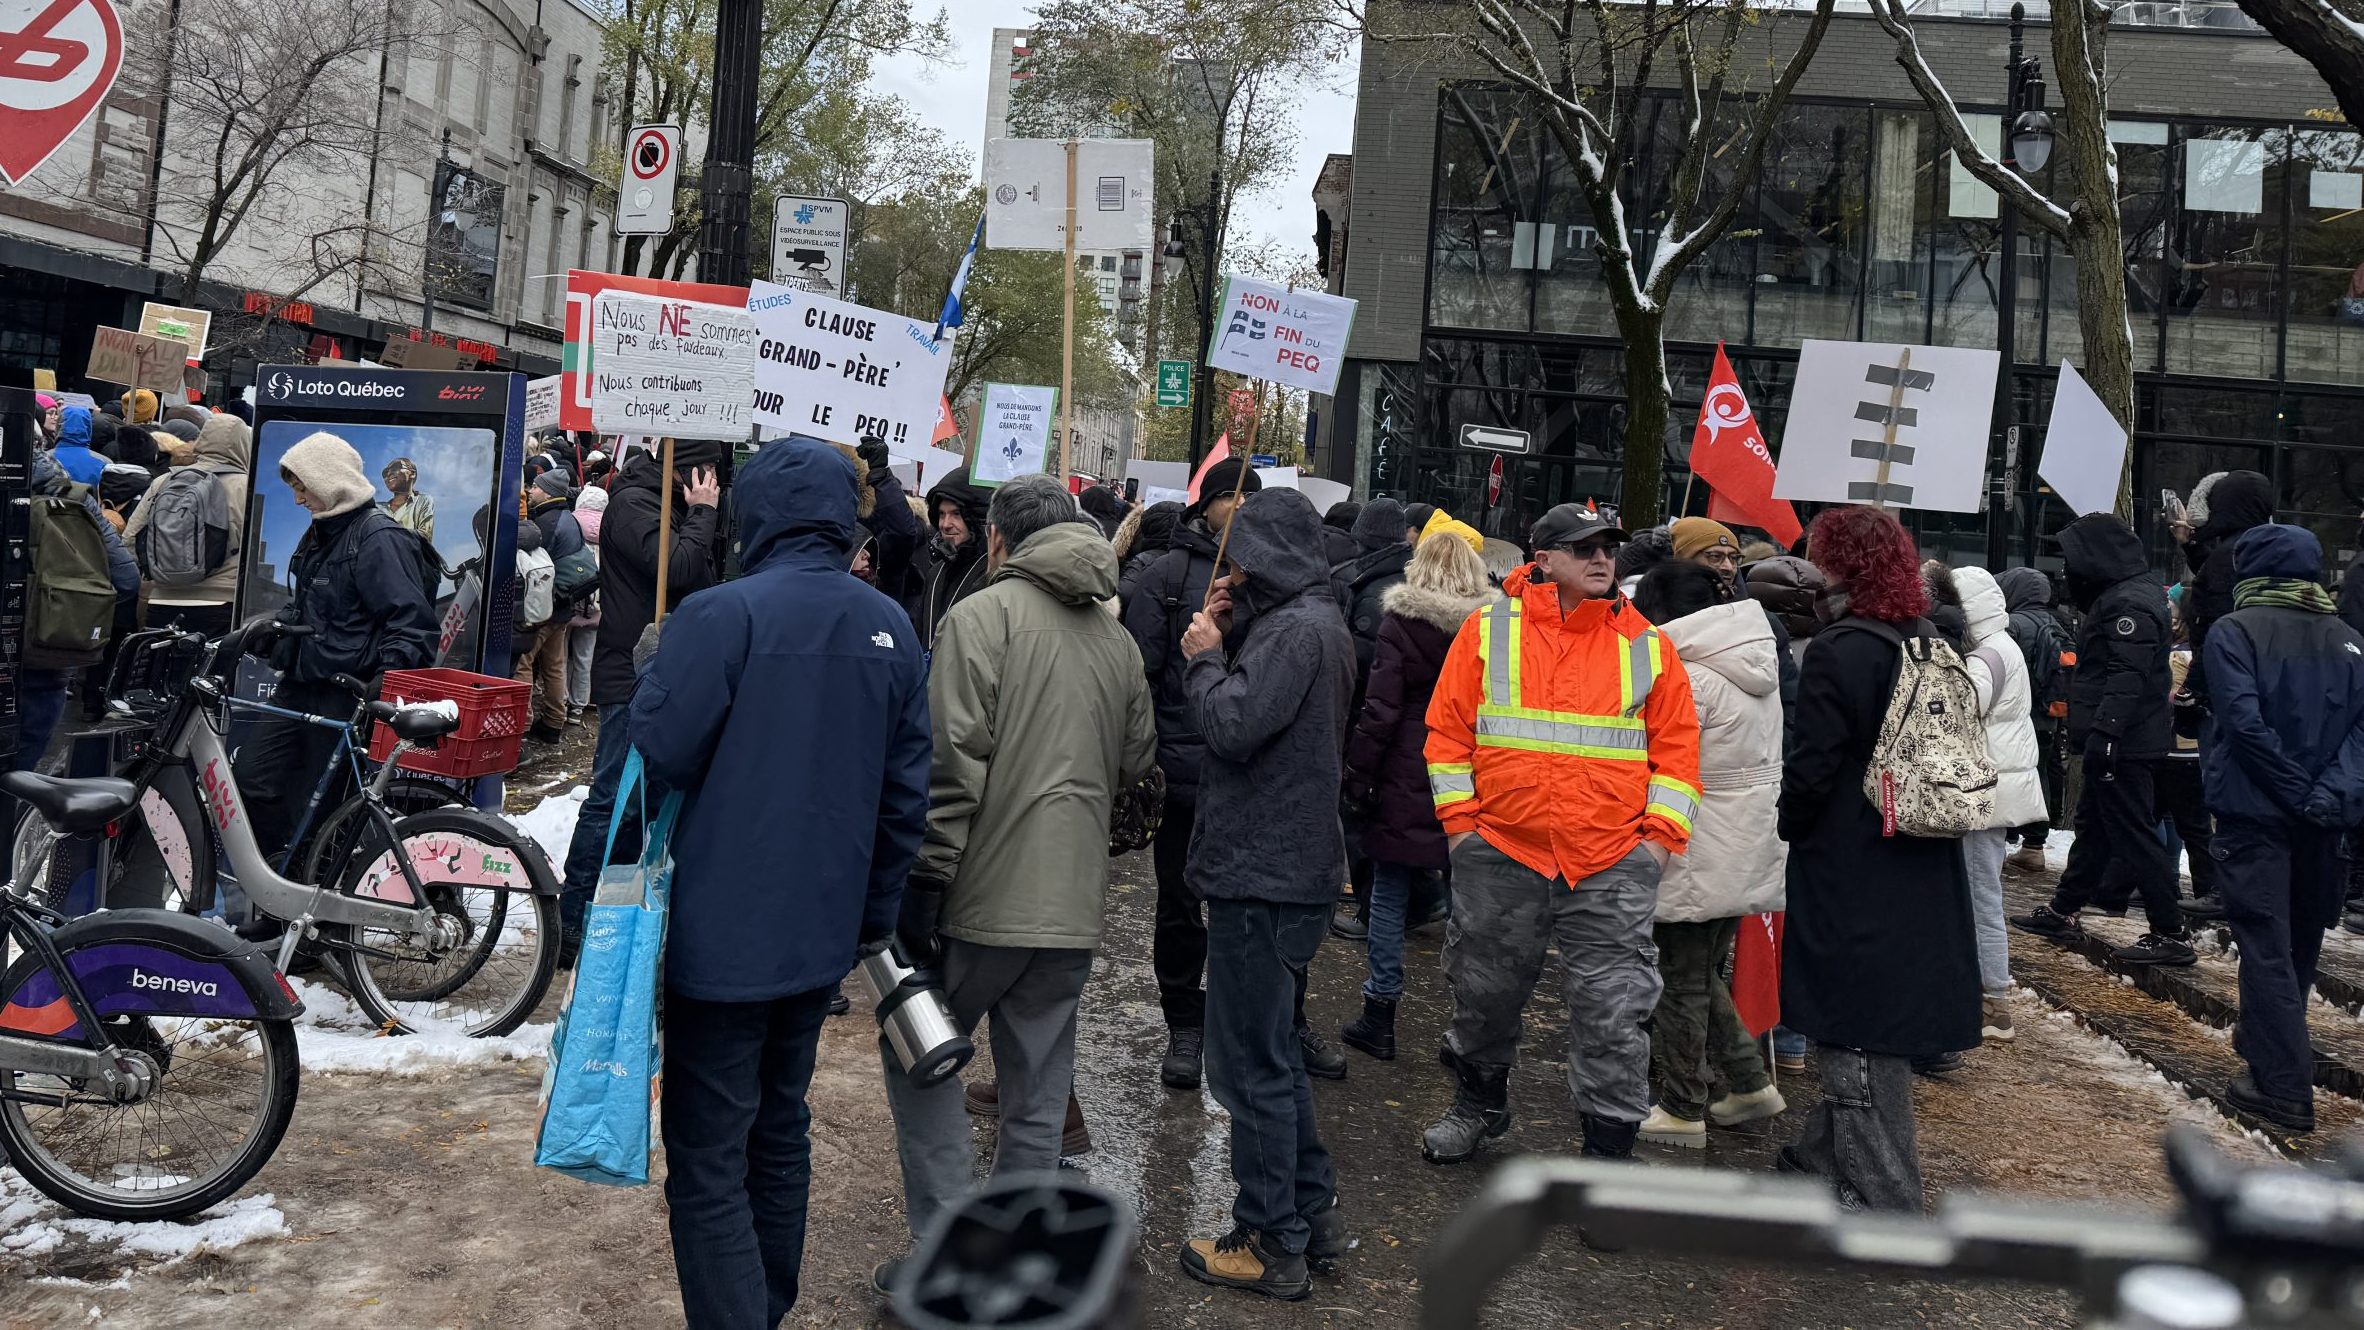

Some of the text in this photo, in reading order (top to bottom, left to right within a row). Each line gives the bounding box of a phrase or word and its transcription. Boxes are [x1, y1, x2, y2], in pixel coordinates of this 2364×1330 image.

[808, 204, 832, 213] SPVM
[780, 227, 803, 235] ESPACE
[780, 237, 840, 248] VIDÉOSURVEILLANCE
[749, 293, 792, 312] ÉTUDES
[1241, 292, 1307, 320] NON À LA
[602, 301, 751, 345] Nous NE sommes
[804, 307, 877, 342] CLAUSE
[617, 333, 637, 355] pas
[649, 334, 667, 351] des
[1274, 325, 1320, 348] FIN DU
[1276, 348, 1320, 373] PEQ
[298, 379, 405, 397] Loto Québec
[599, 372, 702, 393] Nous contribuons
[625, 396, 670, 425] chaque
[681, 400, 708, 416] jour
[811, 403, 833, 426] LE
[1009, 413, 1031, 421] CLAUSE
[998, 422, 1033, 431] GRAND-PÈRE
[132, 968, 217, 997] beneva
